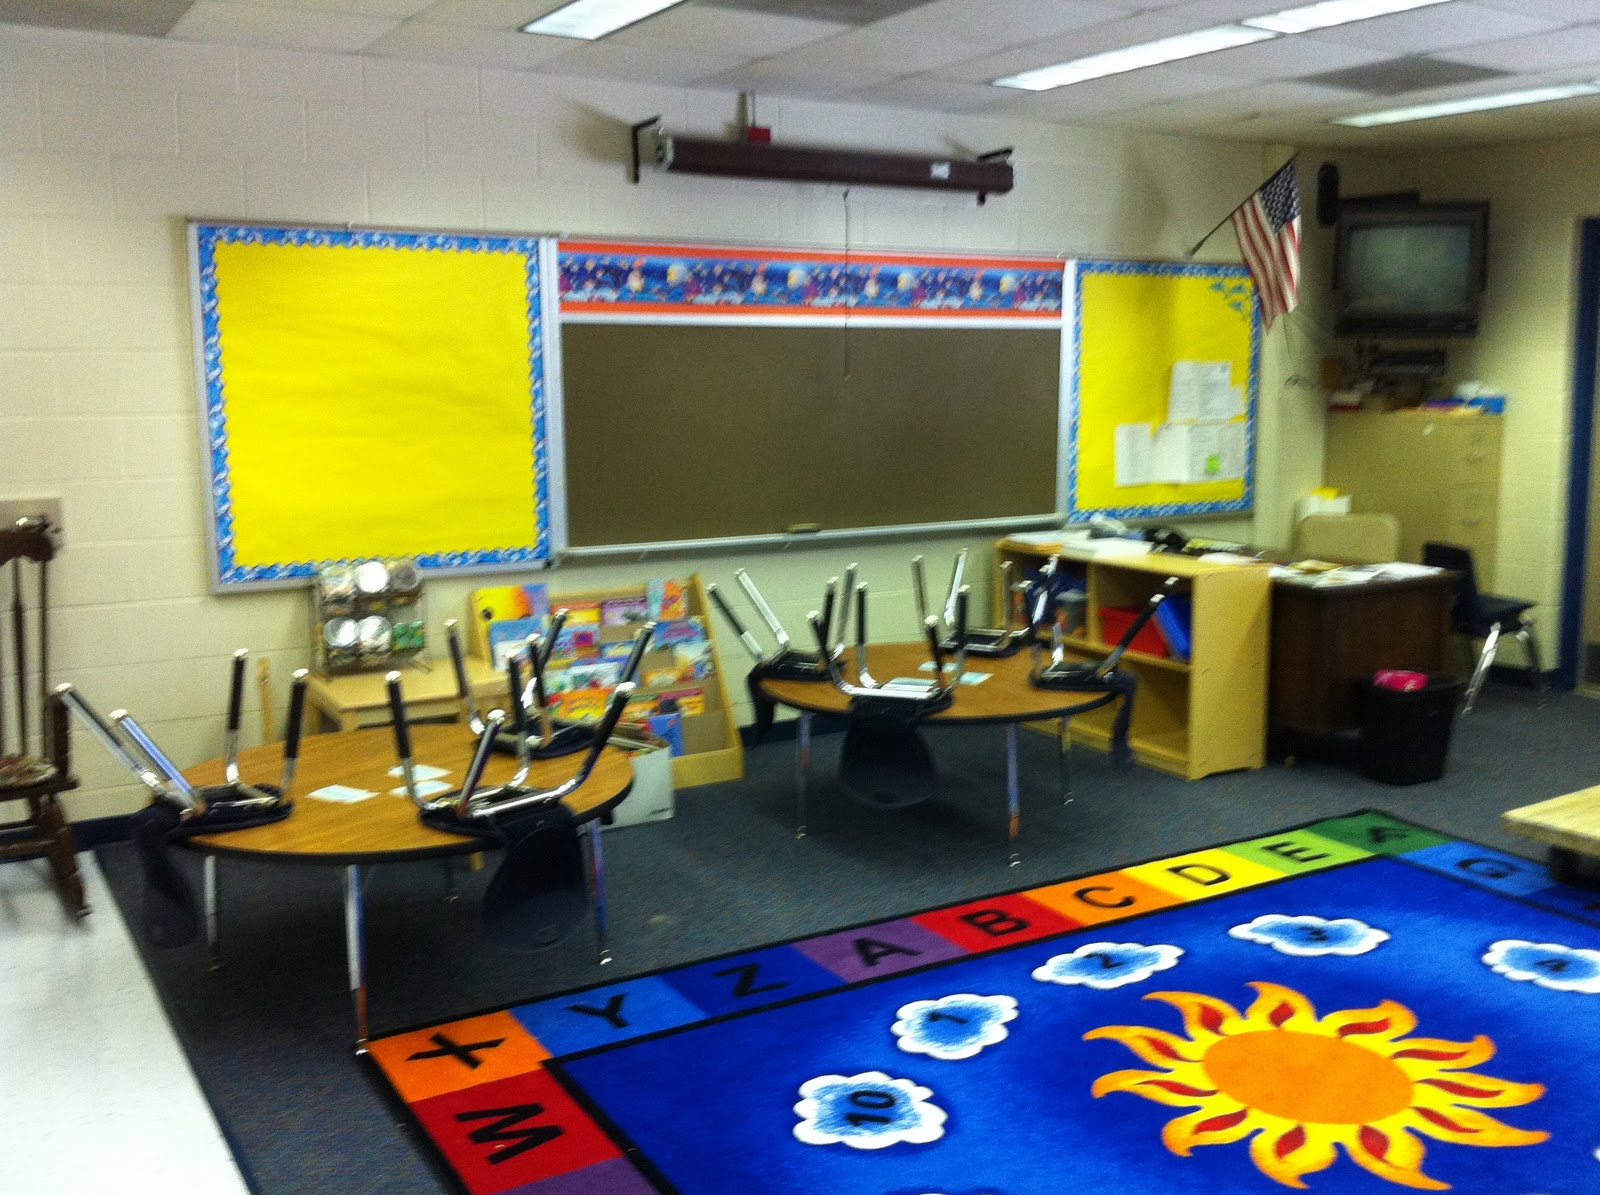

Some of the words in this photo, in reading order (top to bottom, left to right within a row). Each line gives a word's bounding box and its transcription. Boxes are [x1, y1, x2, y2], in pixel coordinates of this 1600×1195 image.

[1456, 857, 1521, 879] G
[405, 1033, 508, 1069] X
[562, 993, 633, 1029] Y
[712, 963, 790, 998] Z
[853, 937, 921, 967] A
[959, 909, 1030, 936] B
[1073, 886, 1137, 908] C
[1166, 863, 1232, 886] D
[1259, 840, 1332, 863] E
[1083, 952, 1126, 969] 2
[926, 1011, 970, 1025] 1
[845, 1089, 896, 1127] 10
